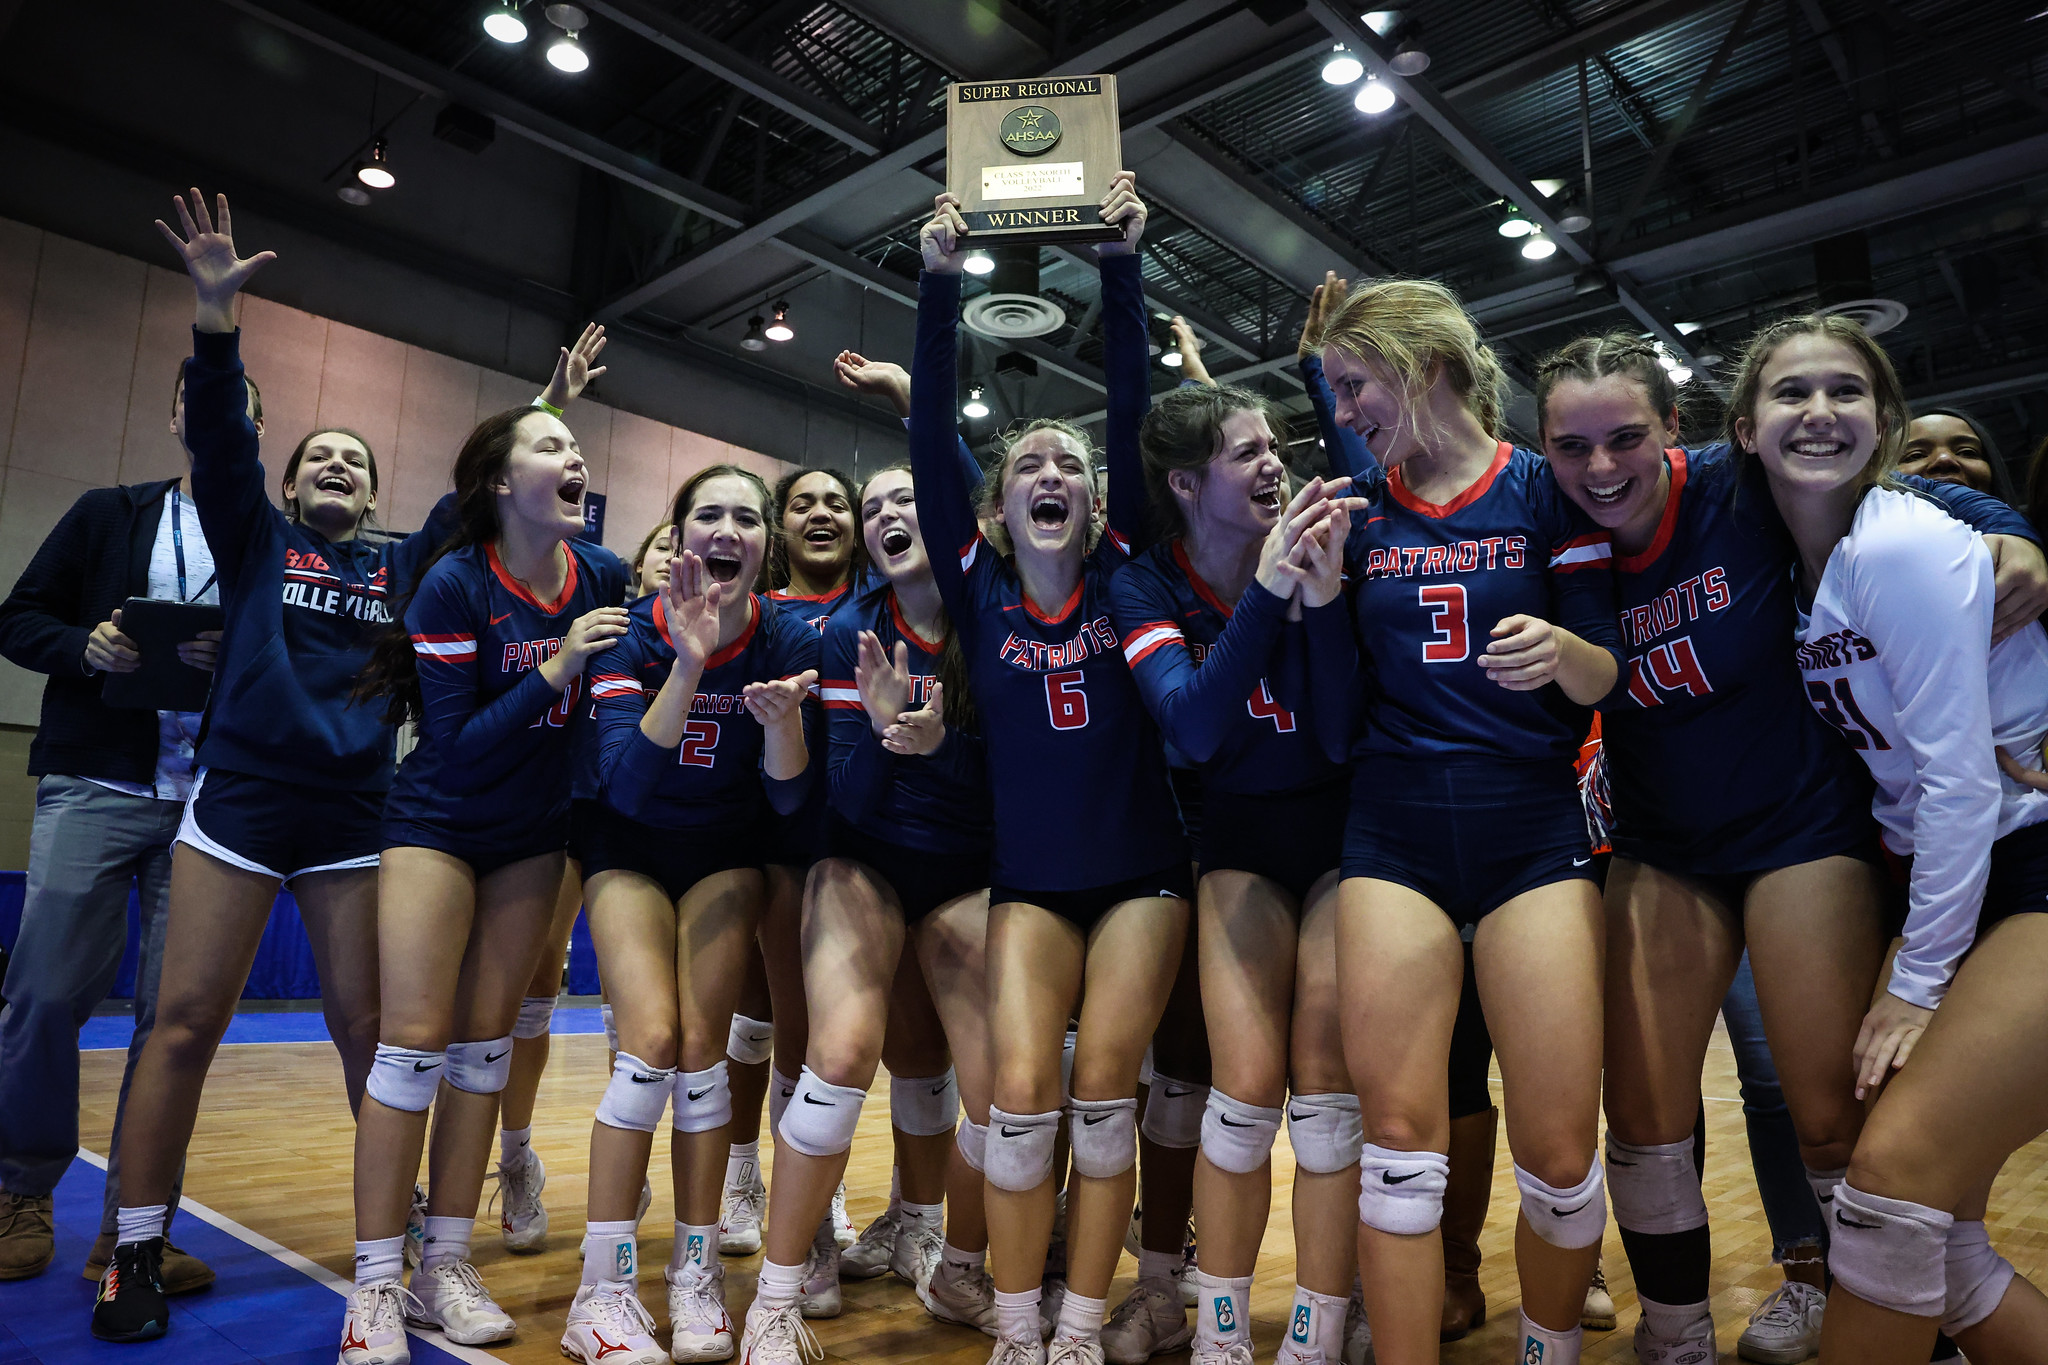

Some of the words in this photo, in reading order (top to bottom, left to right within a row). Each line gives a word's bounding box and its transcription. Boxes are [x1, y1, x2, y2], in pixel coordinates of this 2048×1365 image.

[963, 86, 1011, 100] SUPER
[1018, 80, 1097, 97] REGIONAL
[1005, 130, 1056, 142] AHSAA
[994, 171, 1024, 179] CLASS
[1001, 177, 1062, 186] VOLLEYBALL
[987, 209, 1081, 227] WINNER
[1366, 535, 1527, 580] PATRIOTS
[282, 582, 394, 623] OLLEYBALL
[1419, 583, 1470, 663] 3
[1618, 566, 1731, 647] TRIOTS
[502, 637, 567, 673] PATR
[1000, 616, 1118, 671] PATRIOTS
[1628, 635, 1714, 708] 14
[529, 673, 583, 729] 0
[1044, 670, 1089, 730] 6
[1247, 677, 1296, 733] 4
[1806, 677, 1892, 750] 21
[679, 720, 720, 768] 2
